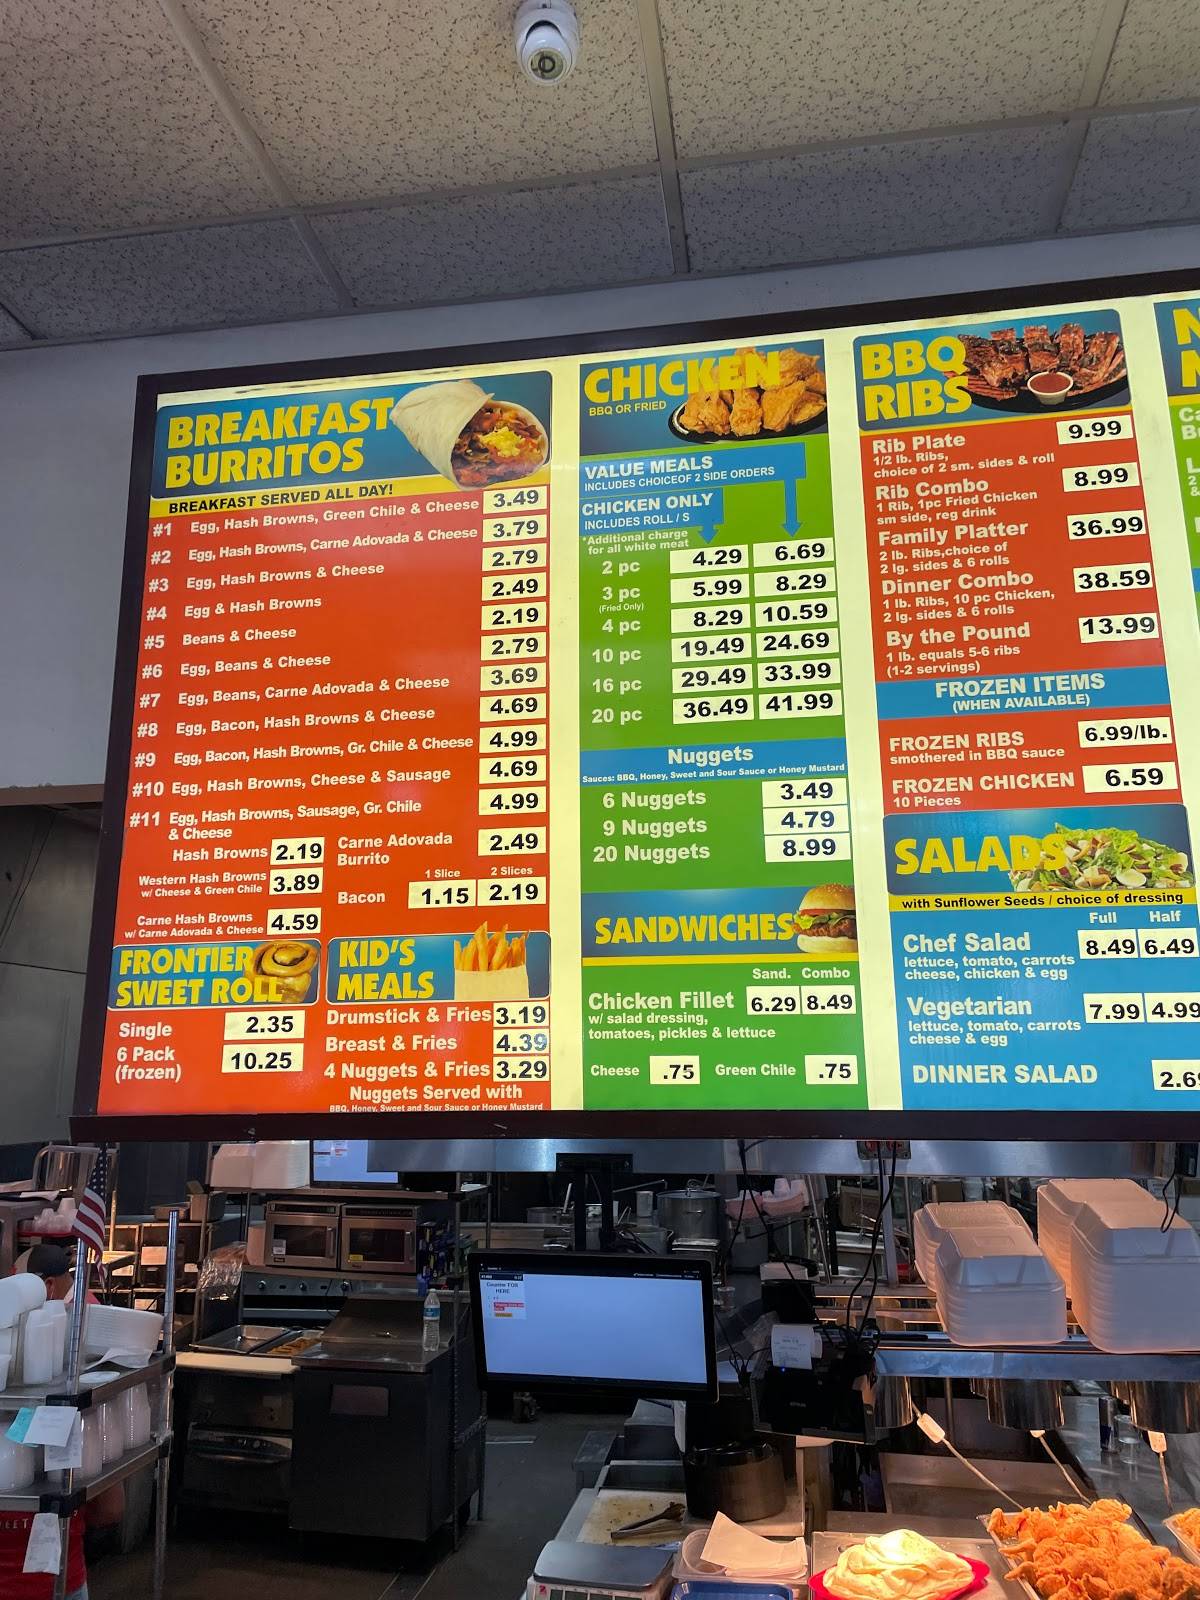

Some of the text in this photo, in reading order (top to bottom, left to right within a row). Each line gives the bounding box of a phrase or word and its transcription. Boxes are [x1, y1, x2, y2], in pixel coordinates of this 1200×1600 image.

[860, 335, 969, 381] BBQ
[583, 350, 781, 404] CHICKEN
[589, 400, 667, 417] BBQ OR FRIED
[863, 375, 973, 422] RIBS
[167, 397, 395, 449] BREAKFAST
[872, 420, 1122, 455] Rib Plate 9.99
[165, 437, 365, 489] BURRITOS
[585, 455, 713, 480] VALUE MEALS
[873, 452, 949, 466] 1/2 lb. Ribs,
[873, 452, 1055, 479] choice of 2 sm. sides & roll
[584, 466, 776, 492] INCLUDES CHOICEOF 2 SIDE ORDERS
[168, 483, 394, 514] BREAKFAST SERVED ALL DAY!
[152, 489, 540, 538] #1 Egg, Hash Browns, Green Chile & Cheese 3.49
[148, 549, 539, 593] #3 Egg, Hash Browns & Cheese 2.79
[602, 542, 826, 576] 2 pc 4.29 6.69
[143, 607, 539, 650] #5 Beans & Cheese 2.19
[139, 667, 538, 709] #7 Egg, Beans, Carne Adovada & Cheese 3.69
[935, 672, 1106, 699] FROZEN ITEMS
[952, 693, 1091, 714] (WHEN AVAILABLE)
[667, 745, 754, 767] Nuggets
[582, 762, 845, 783] Sauces: BBQ, Honey, Sweet and Sour Sauce or Honey Mustard
[892, 767, 1164, 795] FROZEN CHICKEN 6.59
[337, 832, 539, 852] Carne Adovada 2.49
[894, 833, 1068, 876] SALADS
[337, 852, 390, 866] Burrito
[425, 864, 533, 879] 1 Slice 2 Slices
[138, 870, 320, 893] Western Hash Browns 3.89
[141, 883, 262, 898] w/ Cheese & Green Chile
[337, 882, 539, 906] Bacon 1.15 2.19
[901, 897, 930, 910] with
[933, 895, 1000, 909] Sunflower
[1004, 894, 1045, 907] Seeds
[1056, 893, 1102, 906] choice
[1106, 892, 1120, 904] of
[1124, 892, 1184, 906] dressing
[594, 912, 796, 945] SANDWICHES
[1089, 910, 1181, 925] Full Half
[338, 938, 416, 968] KID'S
[902, 932, 1195, 956] Chef Salad 8.49 6.49
[119, 945, 255, 975] FRONTIER
[336, 971, 436, 1000] MEALS
[752, 967, 850, 980] Sand. Combo
[115, 977, 283, 1007] SWEET ROLL
[588, 991, 853, 1012] Chicken Fillet 6.29 8.49
[118, 1015, 294, 1040] Single 2.35
[326, 1005, 547, 1025] Drumstick & Fries 3.19
[116, 1045, 292, 1071] 6 Pack 10.25
[114, 1063, 182, 1083] (frozen)
[590, 1063, 852, 1080] Cheese .75 Green Chile .75
[912, 1064, 1098, 1084] DINNER SALAD
